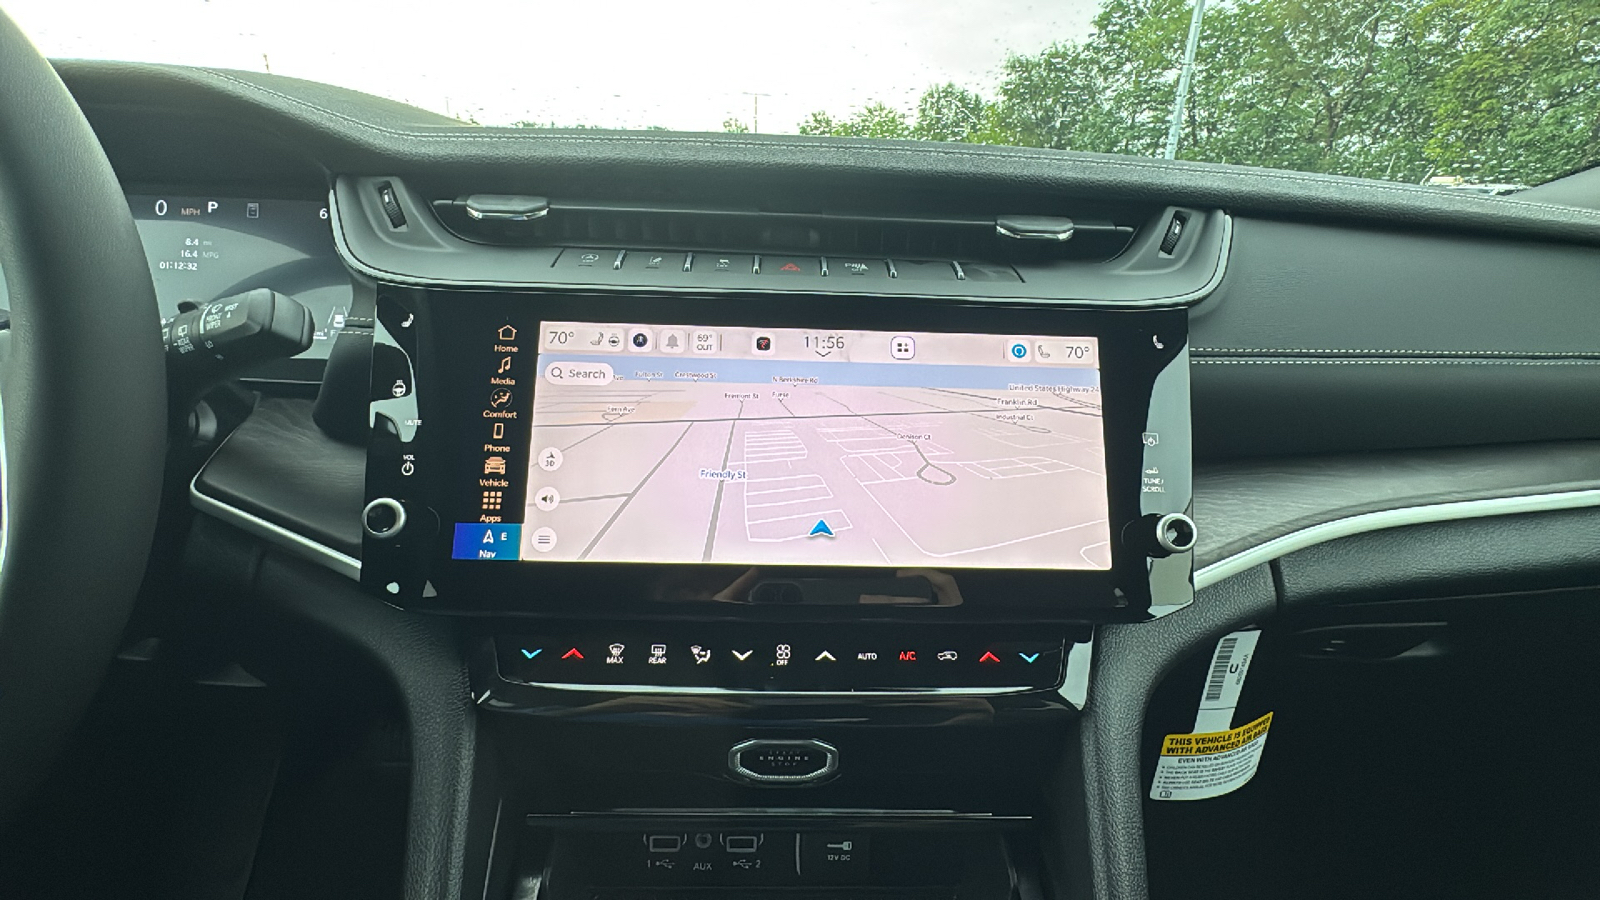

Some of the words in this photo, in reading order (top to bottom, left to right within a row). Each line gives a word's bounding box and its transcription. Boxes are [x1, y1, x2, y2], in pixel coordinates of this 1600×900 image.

[154, 200, 168, 216] 0
[181, 208, 200, 216] MPH
[207, 201, 218, 214] P
[319, 208, 328, 220] 6
[180, 250, 198, 258] 16.4
[548, 331, 575, 344] 70°
[696, 343, 713, 351] OUT
[804, 336, 845, 349] 11:56
[494, 344, 518, 352] Home
[1065, 346, 1091, 359] 70°
[568, 368, 606, 379] Search
[490, 376, 516, 386] Media
[1009, 384, 1034, 392] United
[1057, 386, 1090, 394] Highway
[997, 398, 1026, 406] Franklin
[482, 410, 518, 418] Comfort
[484, 444, 510, 452] Phone
[700, 469, 736, 480] Friendly
[738, 470, 746, 480] St
[480, 478, 509, 487] Vehicle
[480, 514, 502, 523] Apps
[500, 532, 508, 541] E
[479, 550, 496, 559] Nav
[606, 656, 624, 664] MAX
[648, 656, 667, 664] REAR
[857, 652, 878, 661] AUTO
[899, 651, 916, 661] A/C
[1166, 746, 1194, 754] WITH
[1194, 740, 1241, 754] ADVANCED
[1242, 734, 1252, 743] AIR
[1253, 726, 1268, 738] BAGS
[1169, 738, 1193, 746] THIS
[1195, 734, 1232, 745] VEHICLE
[692, 862, 712, 870] AUX
[755, 860, 762, 868] 2
